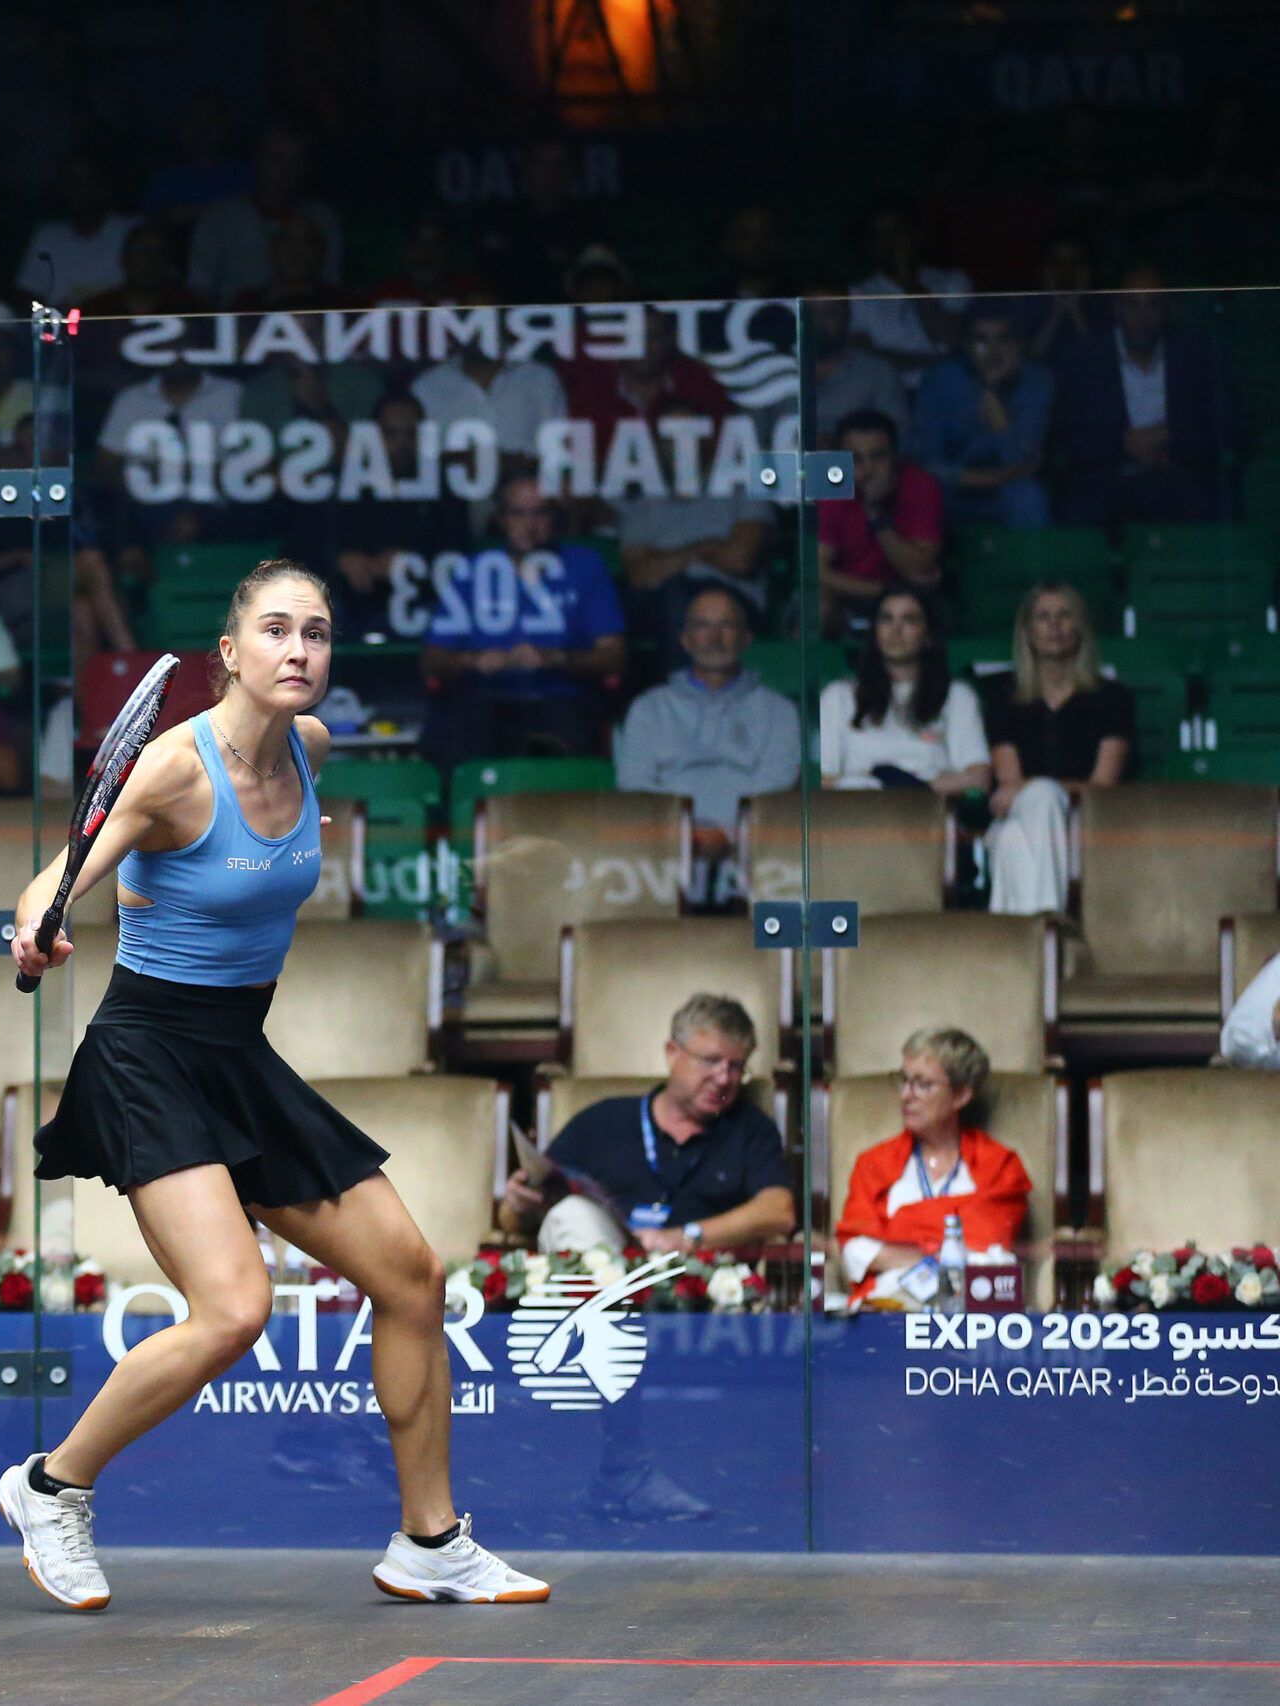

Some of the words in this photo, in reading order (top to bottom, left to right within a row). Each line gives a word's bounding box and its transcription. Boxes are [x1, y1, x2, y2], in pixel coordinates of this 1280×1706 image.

[989, 52, 1185, 112] QATAR
[435, 144, 622, 199] QAR
[226, 857, 271, 871] STELLAR
[904, 1312, 1033, 1351] EXPO
[1041, 1312, 1161, 1351] 2023
[193, 1380, 359, 1415] AIRWAYS
[904, 1366, 1000, 1397] DOHA
[1006, 1366, 1112, 1398] QATAR
[1124, 1367, 1191, 1404] قطر
